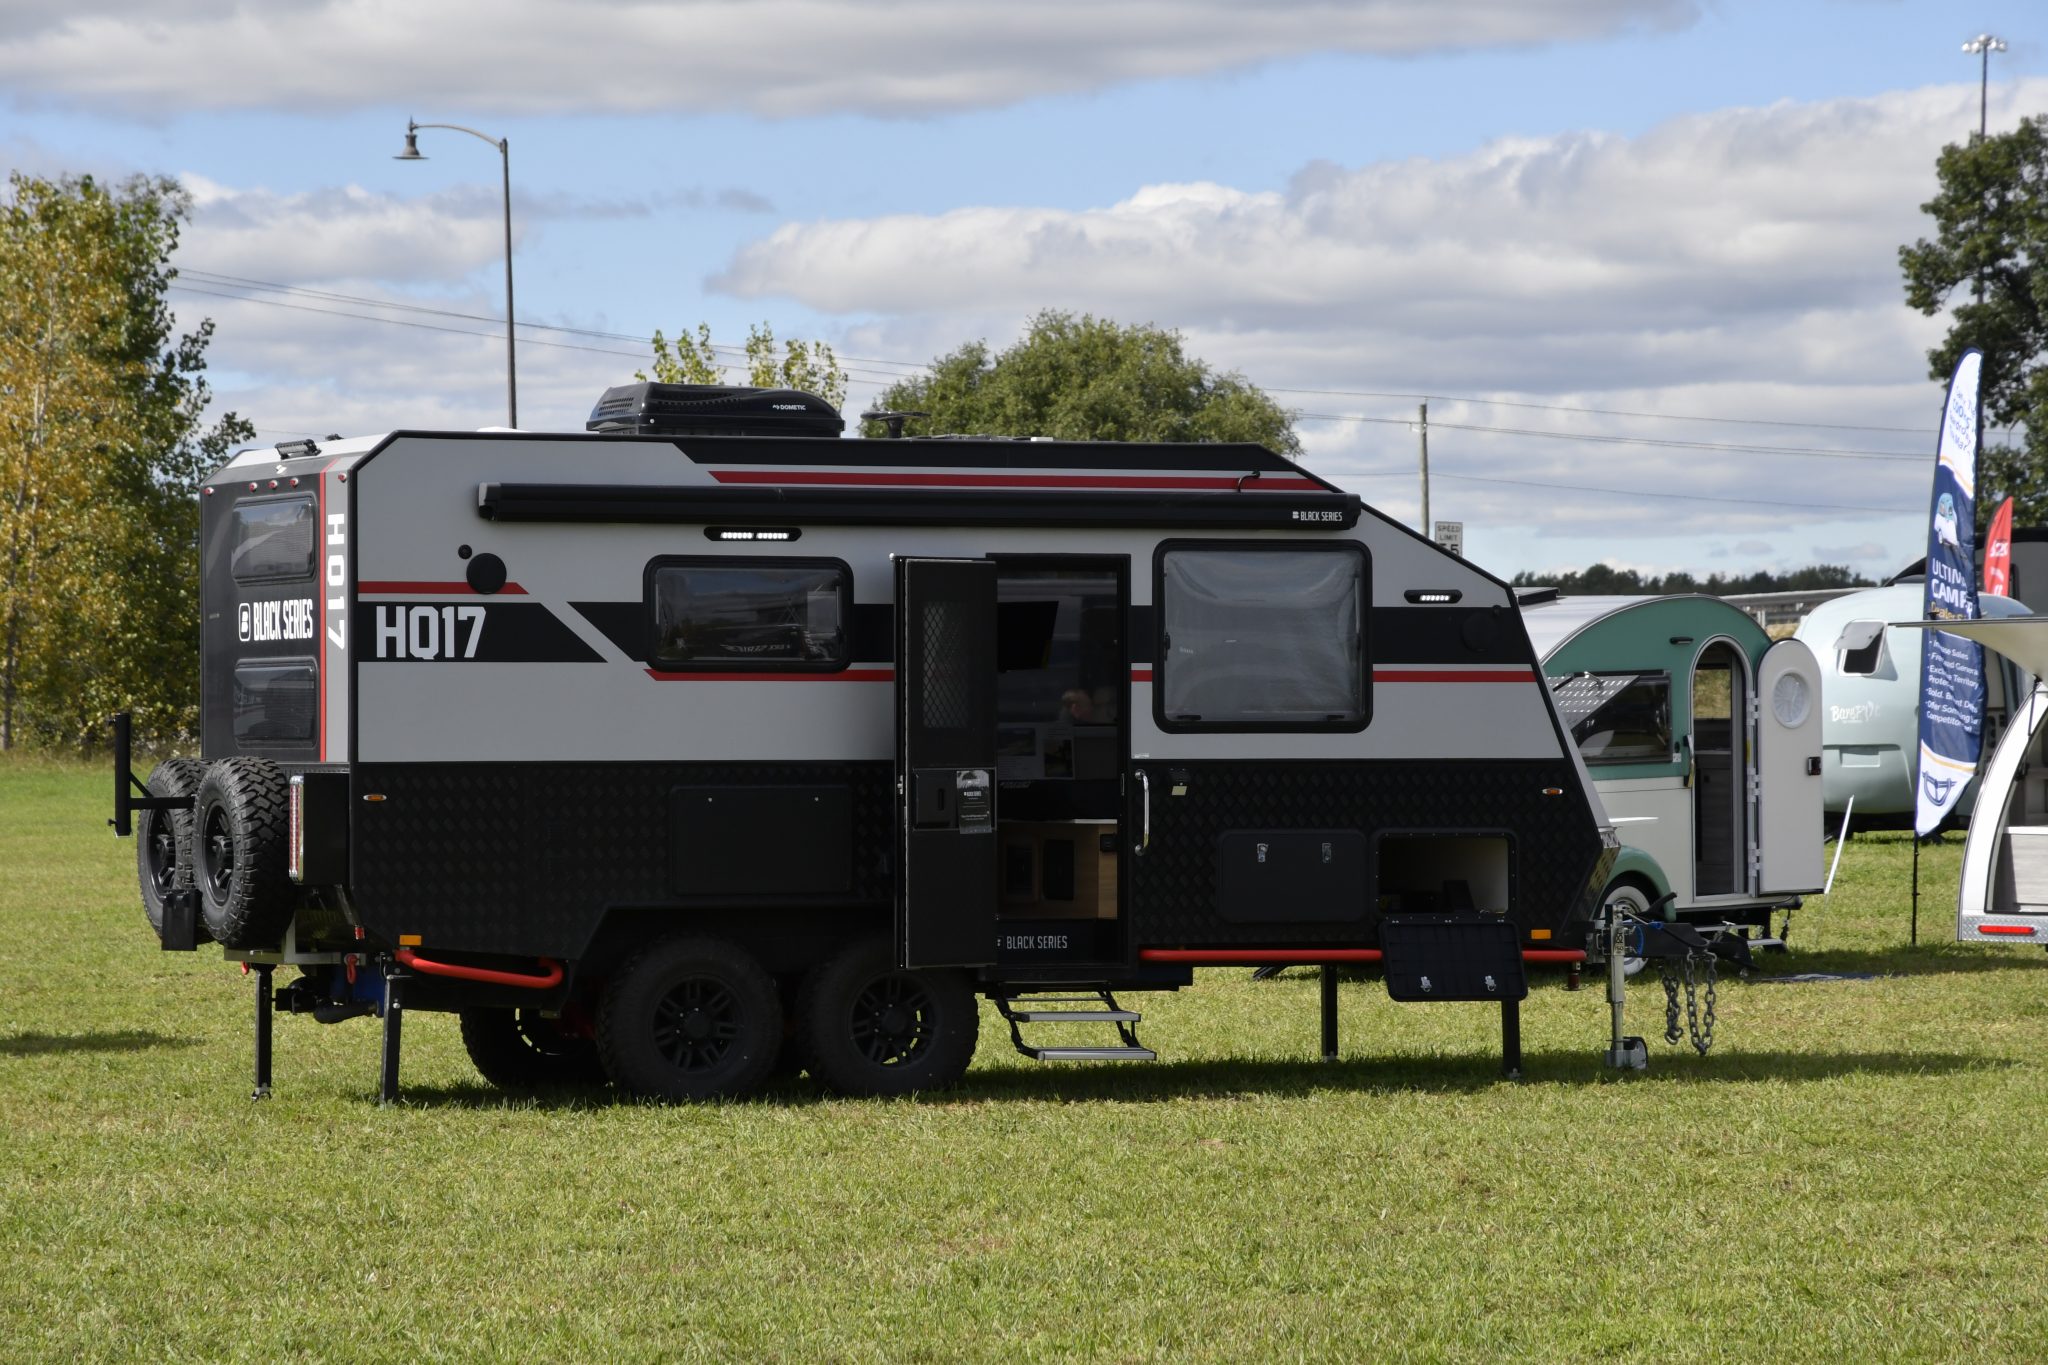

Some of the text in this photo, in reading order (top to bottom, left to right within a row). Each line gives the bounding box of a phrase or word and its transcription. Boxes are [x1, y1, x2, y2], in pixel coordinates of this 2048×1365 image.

[1301, 511, 1343, 521] BLACK SERIES
[253, 600, 281, 641] BLACK
[283, 598, 313, 640] SERIES
[375, 605, 487, 660] HQ17
[1006, 935, 1068, 950] BLACK SERIES
